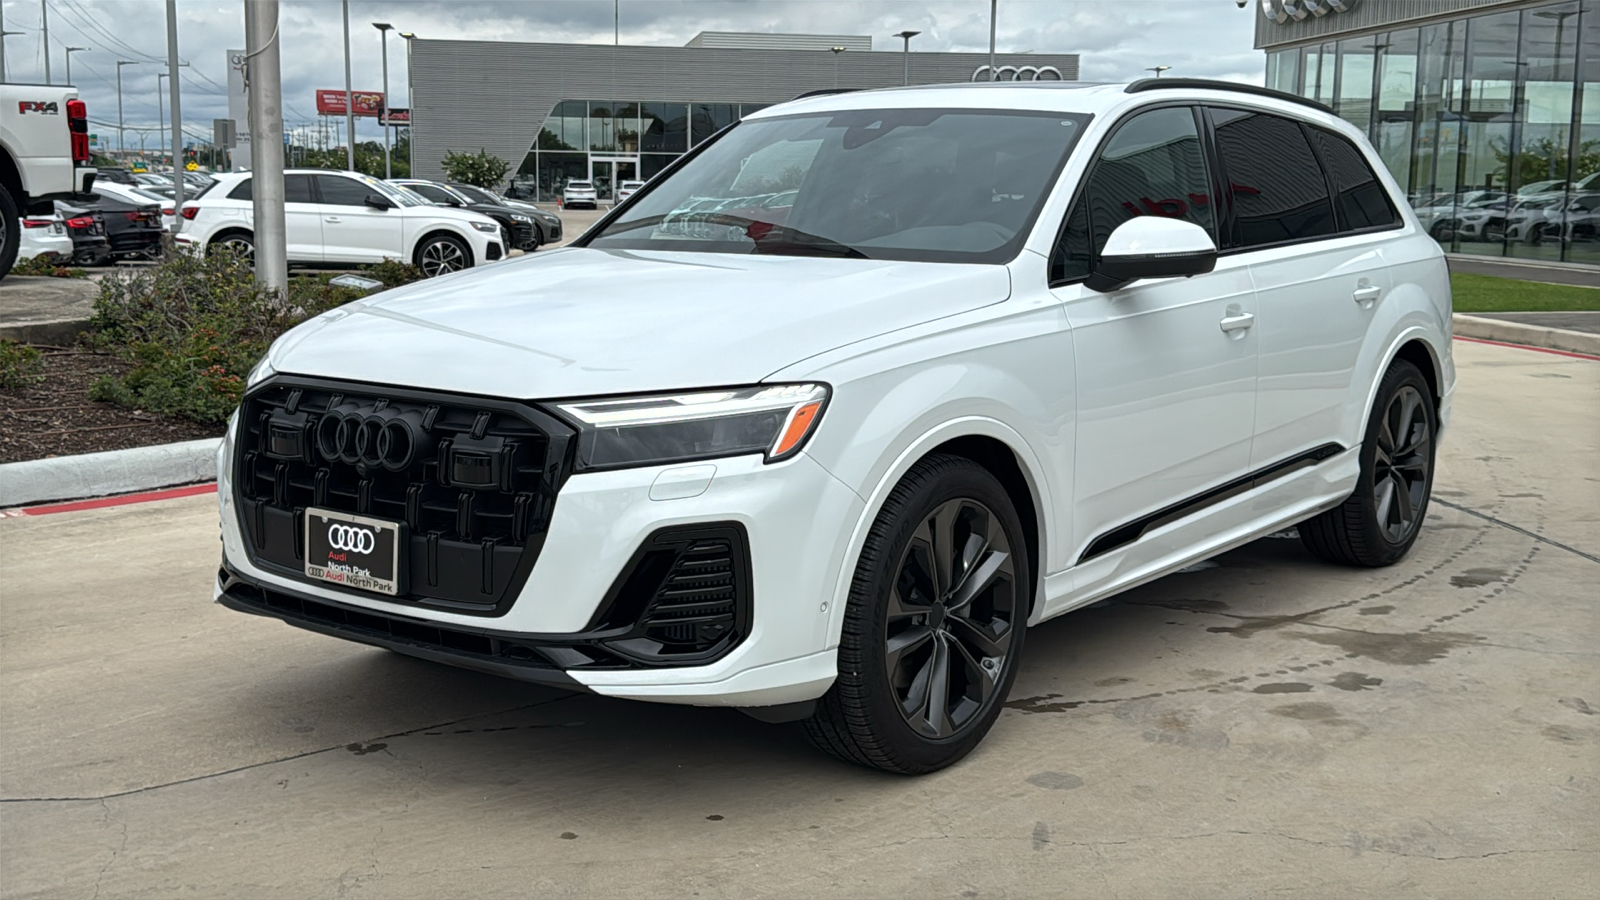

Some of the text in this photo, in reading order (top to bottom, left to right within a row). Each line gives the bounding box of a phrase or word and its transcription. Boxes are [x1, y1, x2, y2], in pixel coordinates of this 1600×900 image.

[19, 101, 58, 114] FX4
[328, 551, 347, 561] Audi
[328, 561, 371, 577] North Park
[325, 571, 393, 593] Audi North Park
